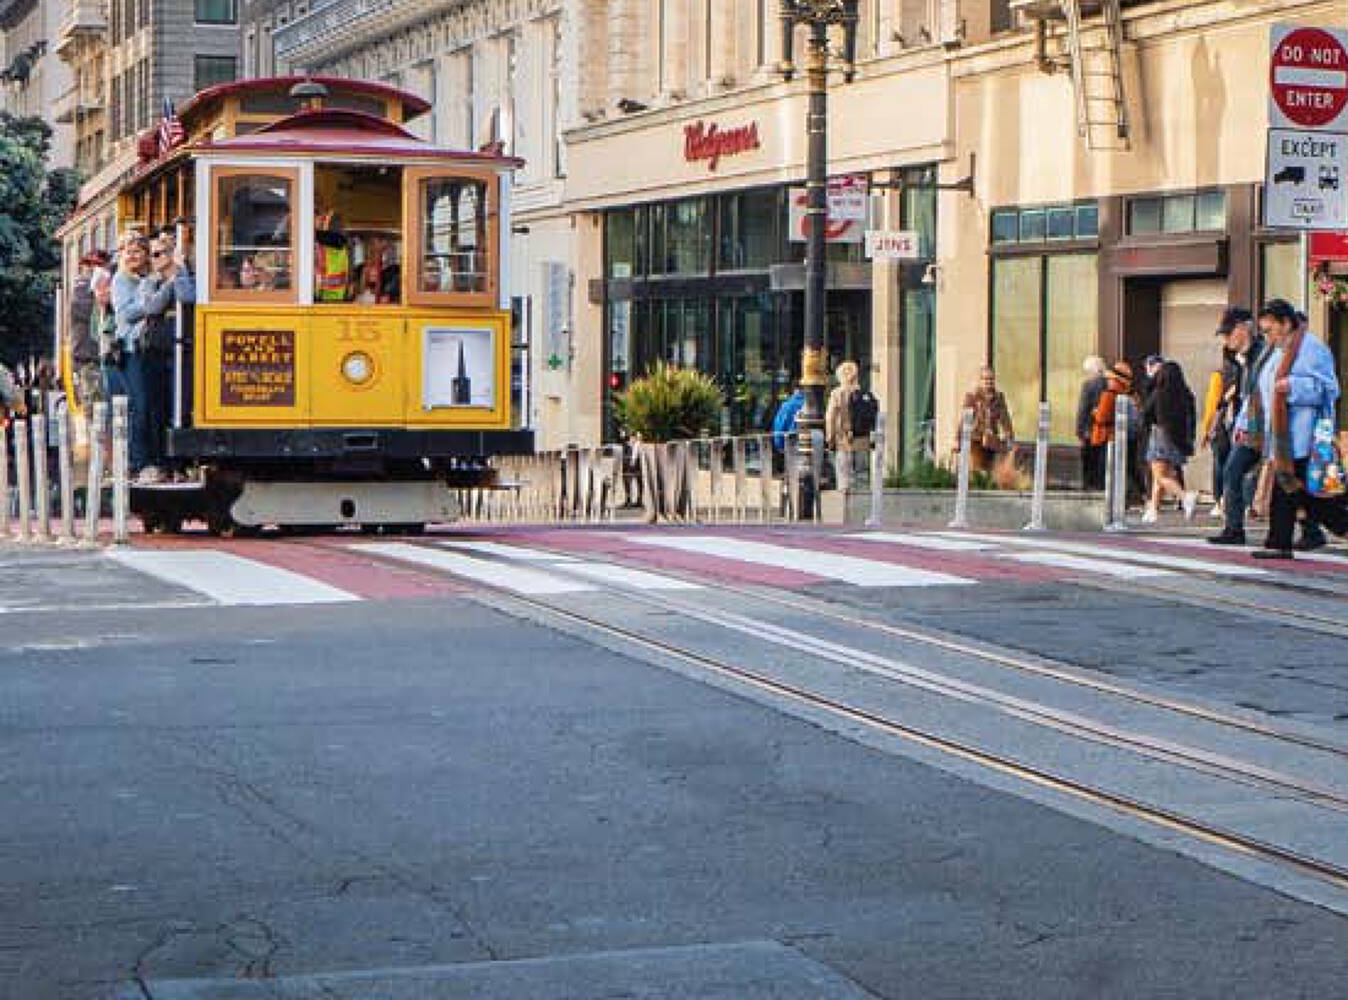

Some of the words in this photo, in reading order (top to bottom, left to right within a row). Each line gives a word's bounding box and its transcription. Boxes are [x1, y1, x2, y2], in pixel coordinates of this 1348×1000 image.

[1281, 45, 1302, 63] DO
[1310, 47, 1341, 65] NOT
[1286, 90, 1335, 109] ENTER
[1280, 138, 1337, 158] EXCEPT
[225, 335, 288, 346] POWELL
[223, 352, 292, 363] MARKET
